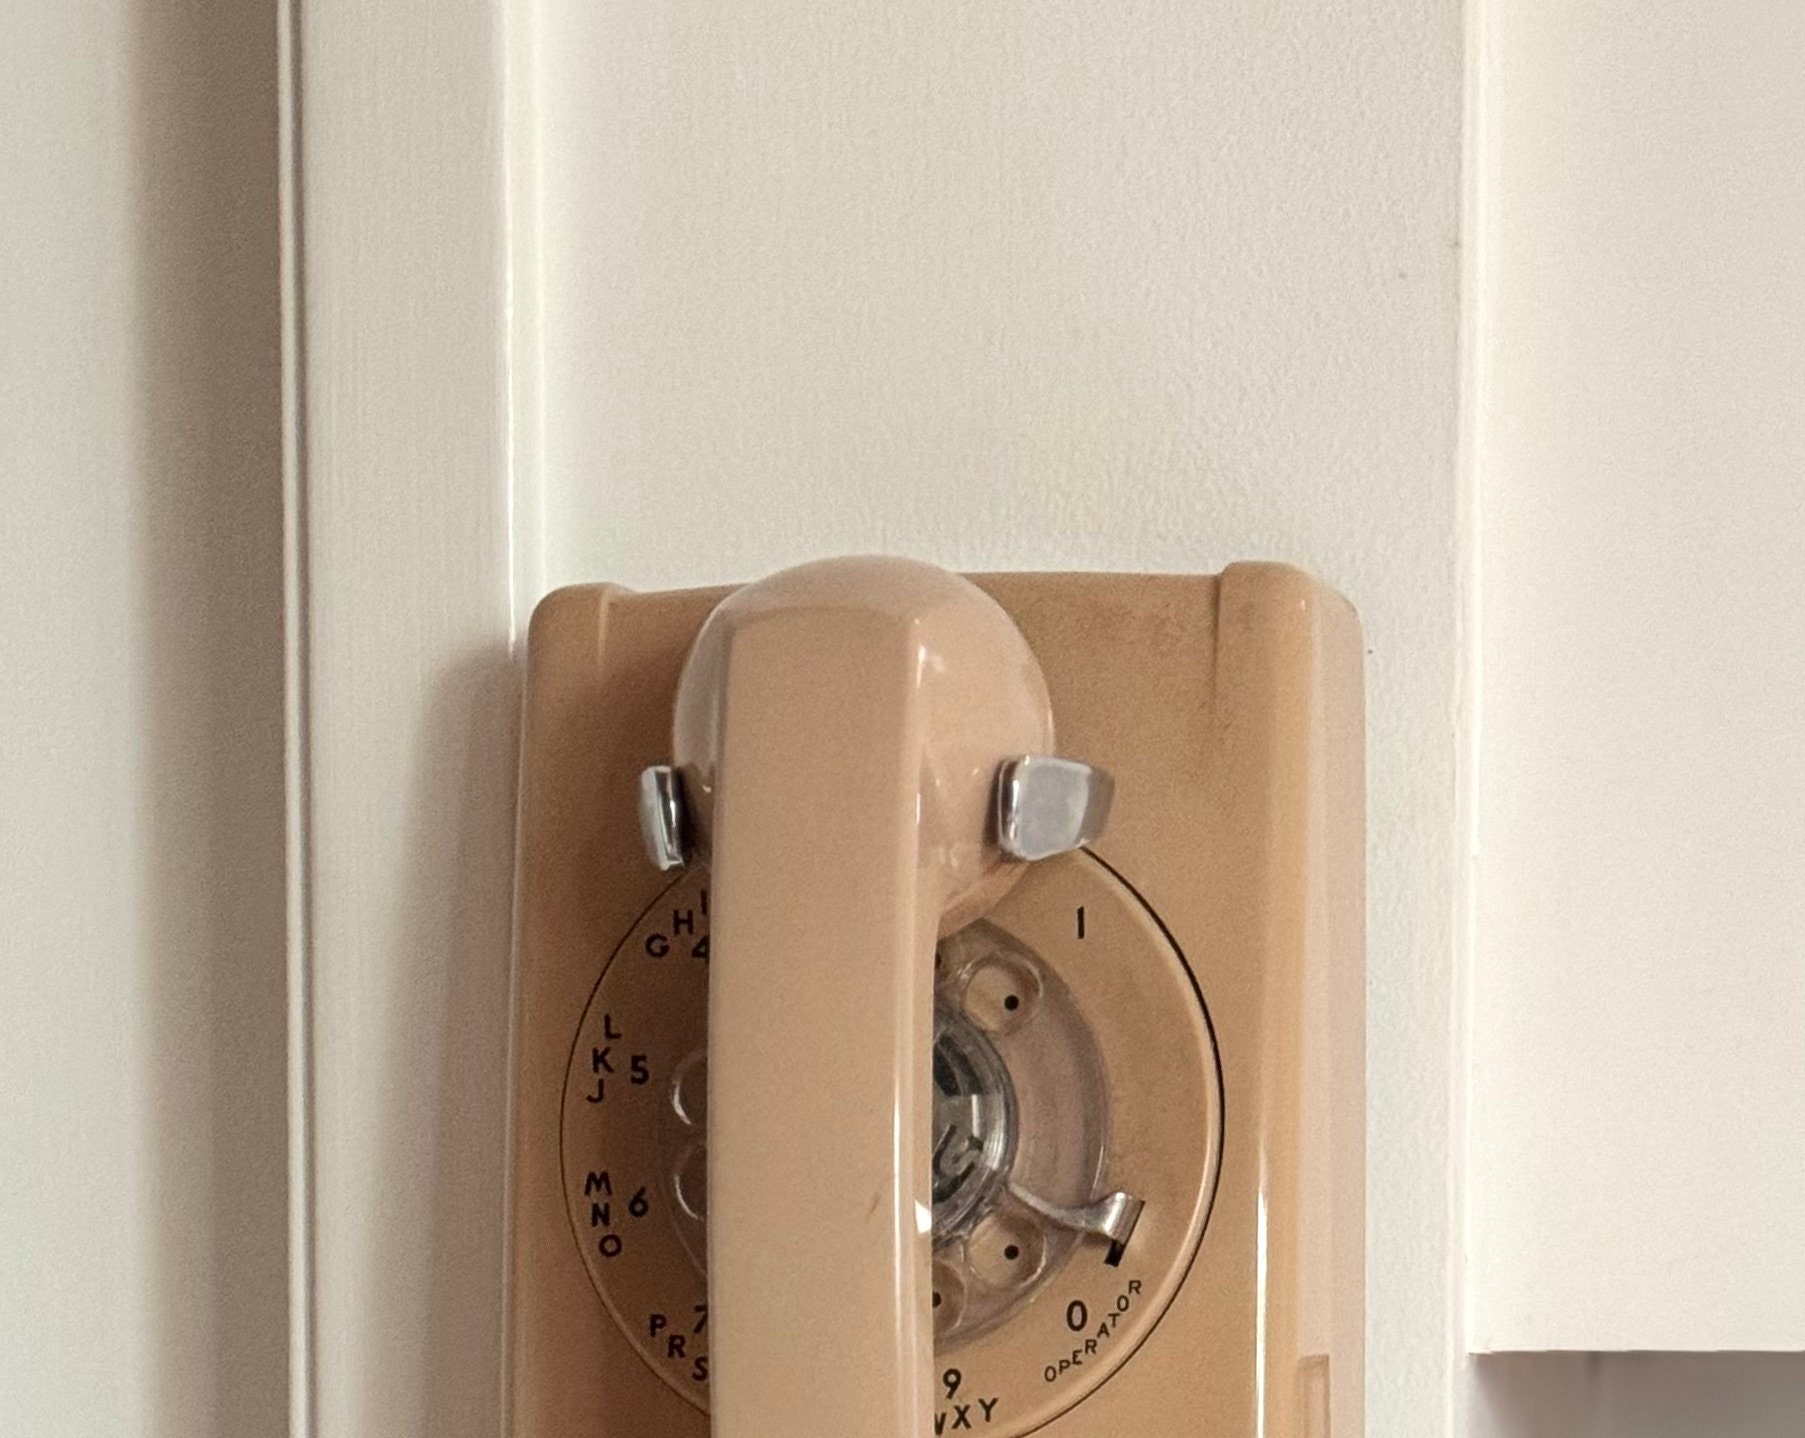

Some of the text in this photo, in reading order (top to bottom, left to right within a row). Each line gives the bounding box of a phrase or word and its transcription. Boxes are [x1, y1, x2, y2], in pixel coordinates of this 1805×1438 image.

[691, 934, 710, 965] 4
[630, 1055, 649, 1085] 5
[628, 1186, 649, 1218] 6
[693, 1304, 708, 1334] 7
[1044, 1280, 1142, 1382] OPERATOR
[649, 1313, 708, 1382] PRS
[942, 1368, 962, 1400] 9
